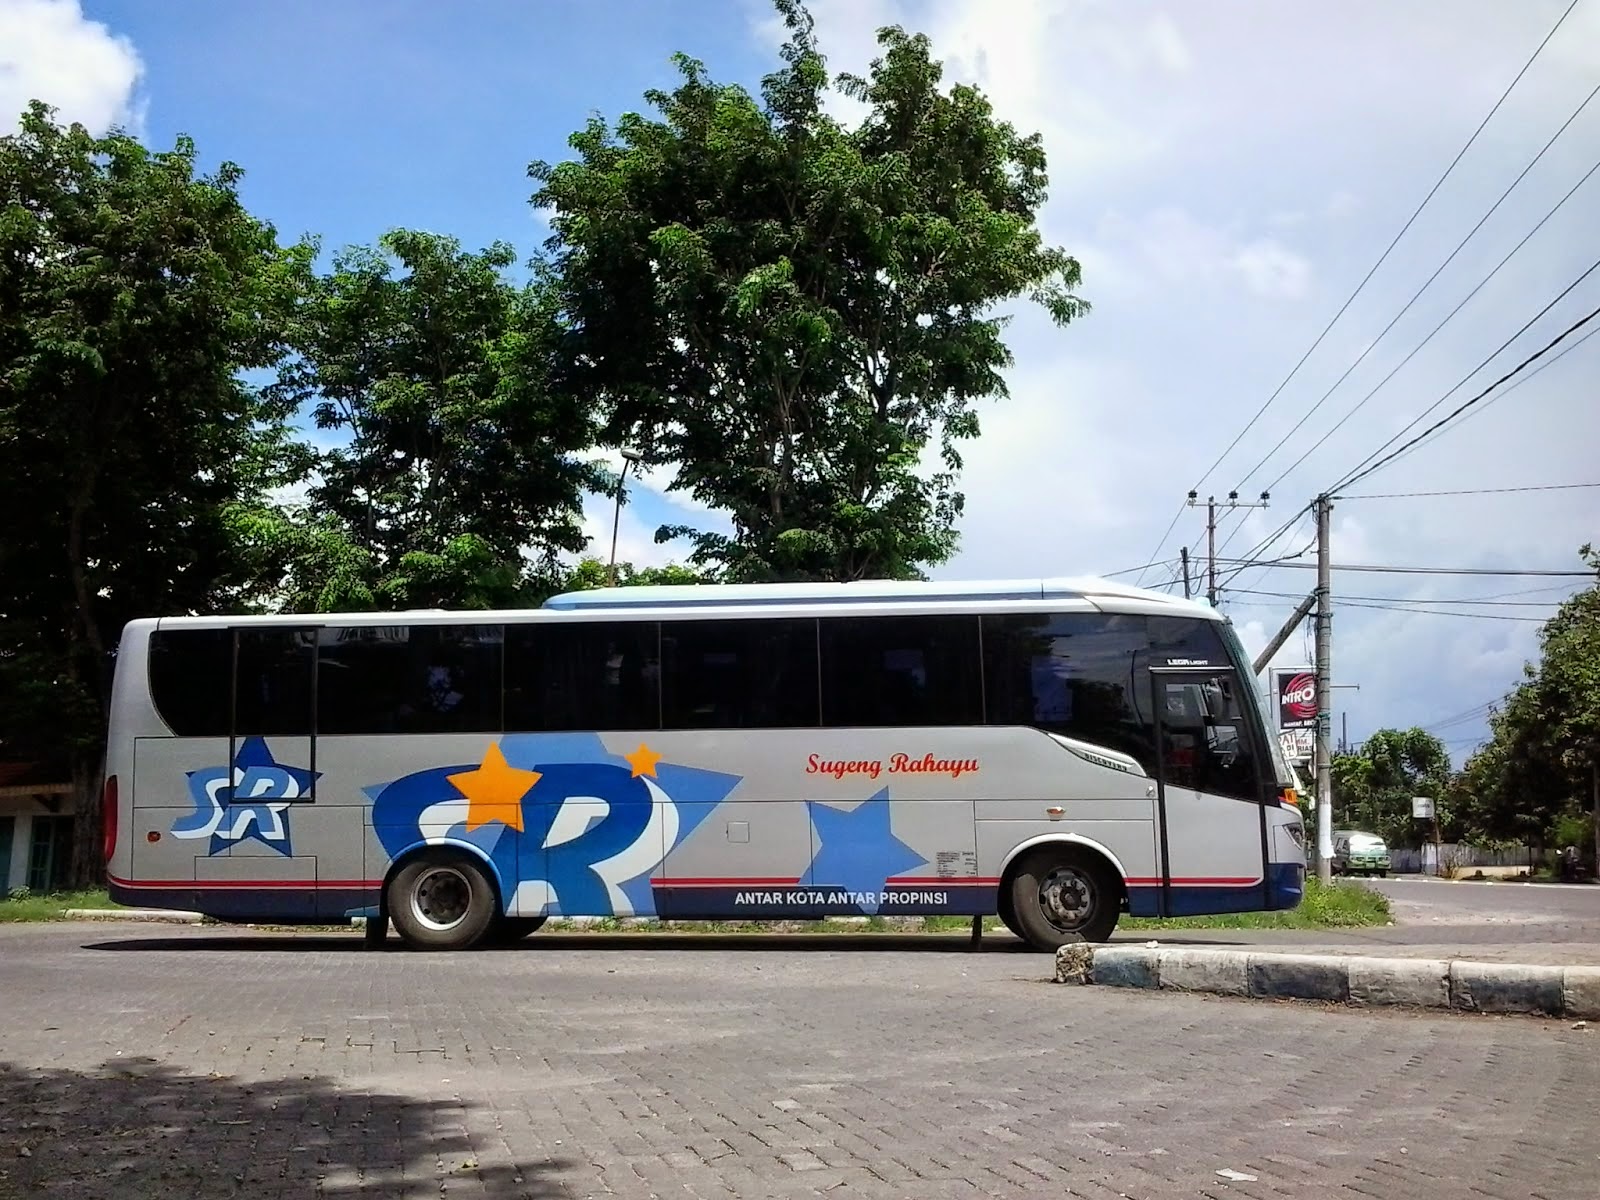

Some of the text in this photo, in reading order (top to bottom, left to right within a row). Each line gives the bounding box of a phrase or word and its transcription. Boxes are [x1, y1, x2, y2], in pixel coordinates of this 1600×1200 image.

[1281, 687, 1315, 705] INTRO
[805, 752, 979, 780] Sugeng Rahayu
[170, 766, 300, 840] SR
[734, 892, 948, 905] ANTAR KOTA ANTAR PROPINSI
